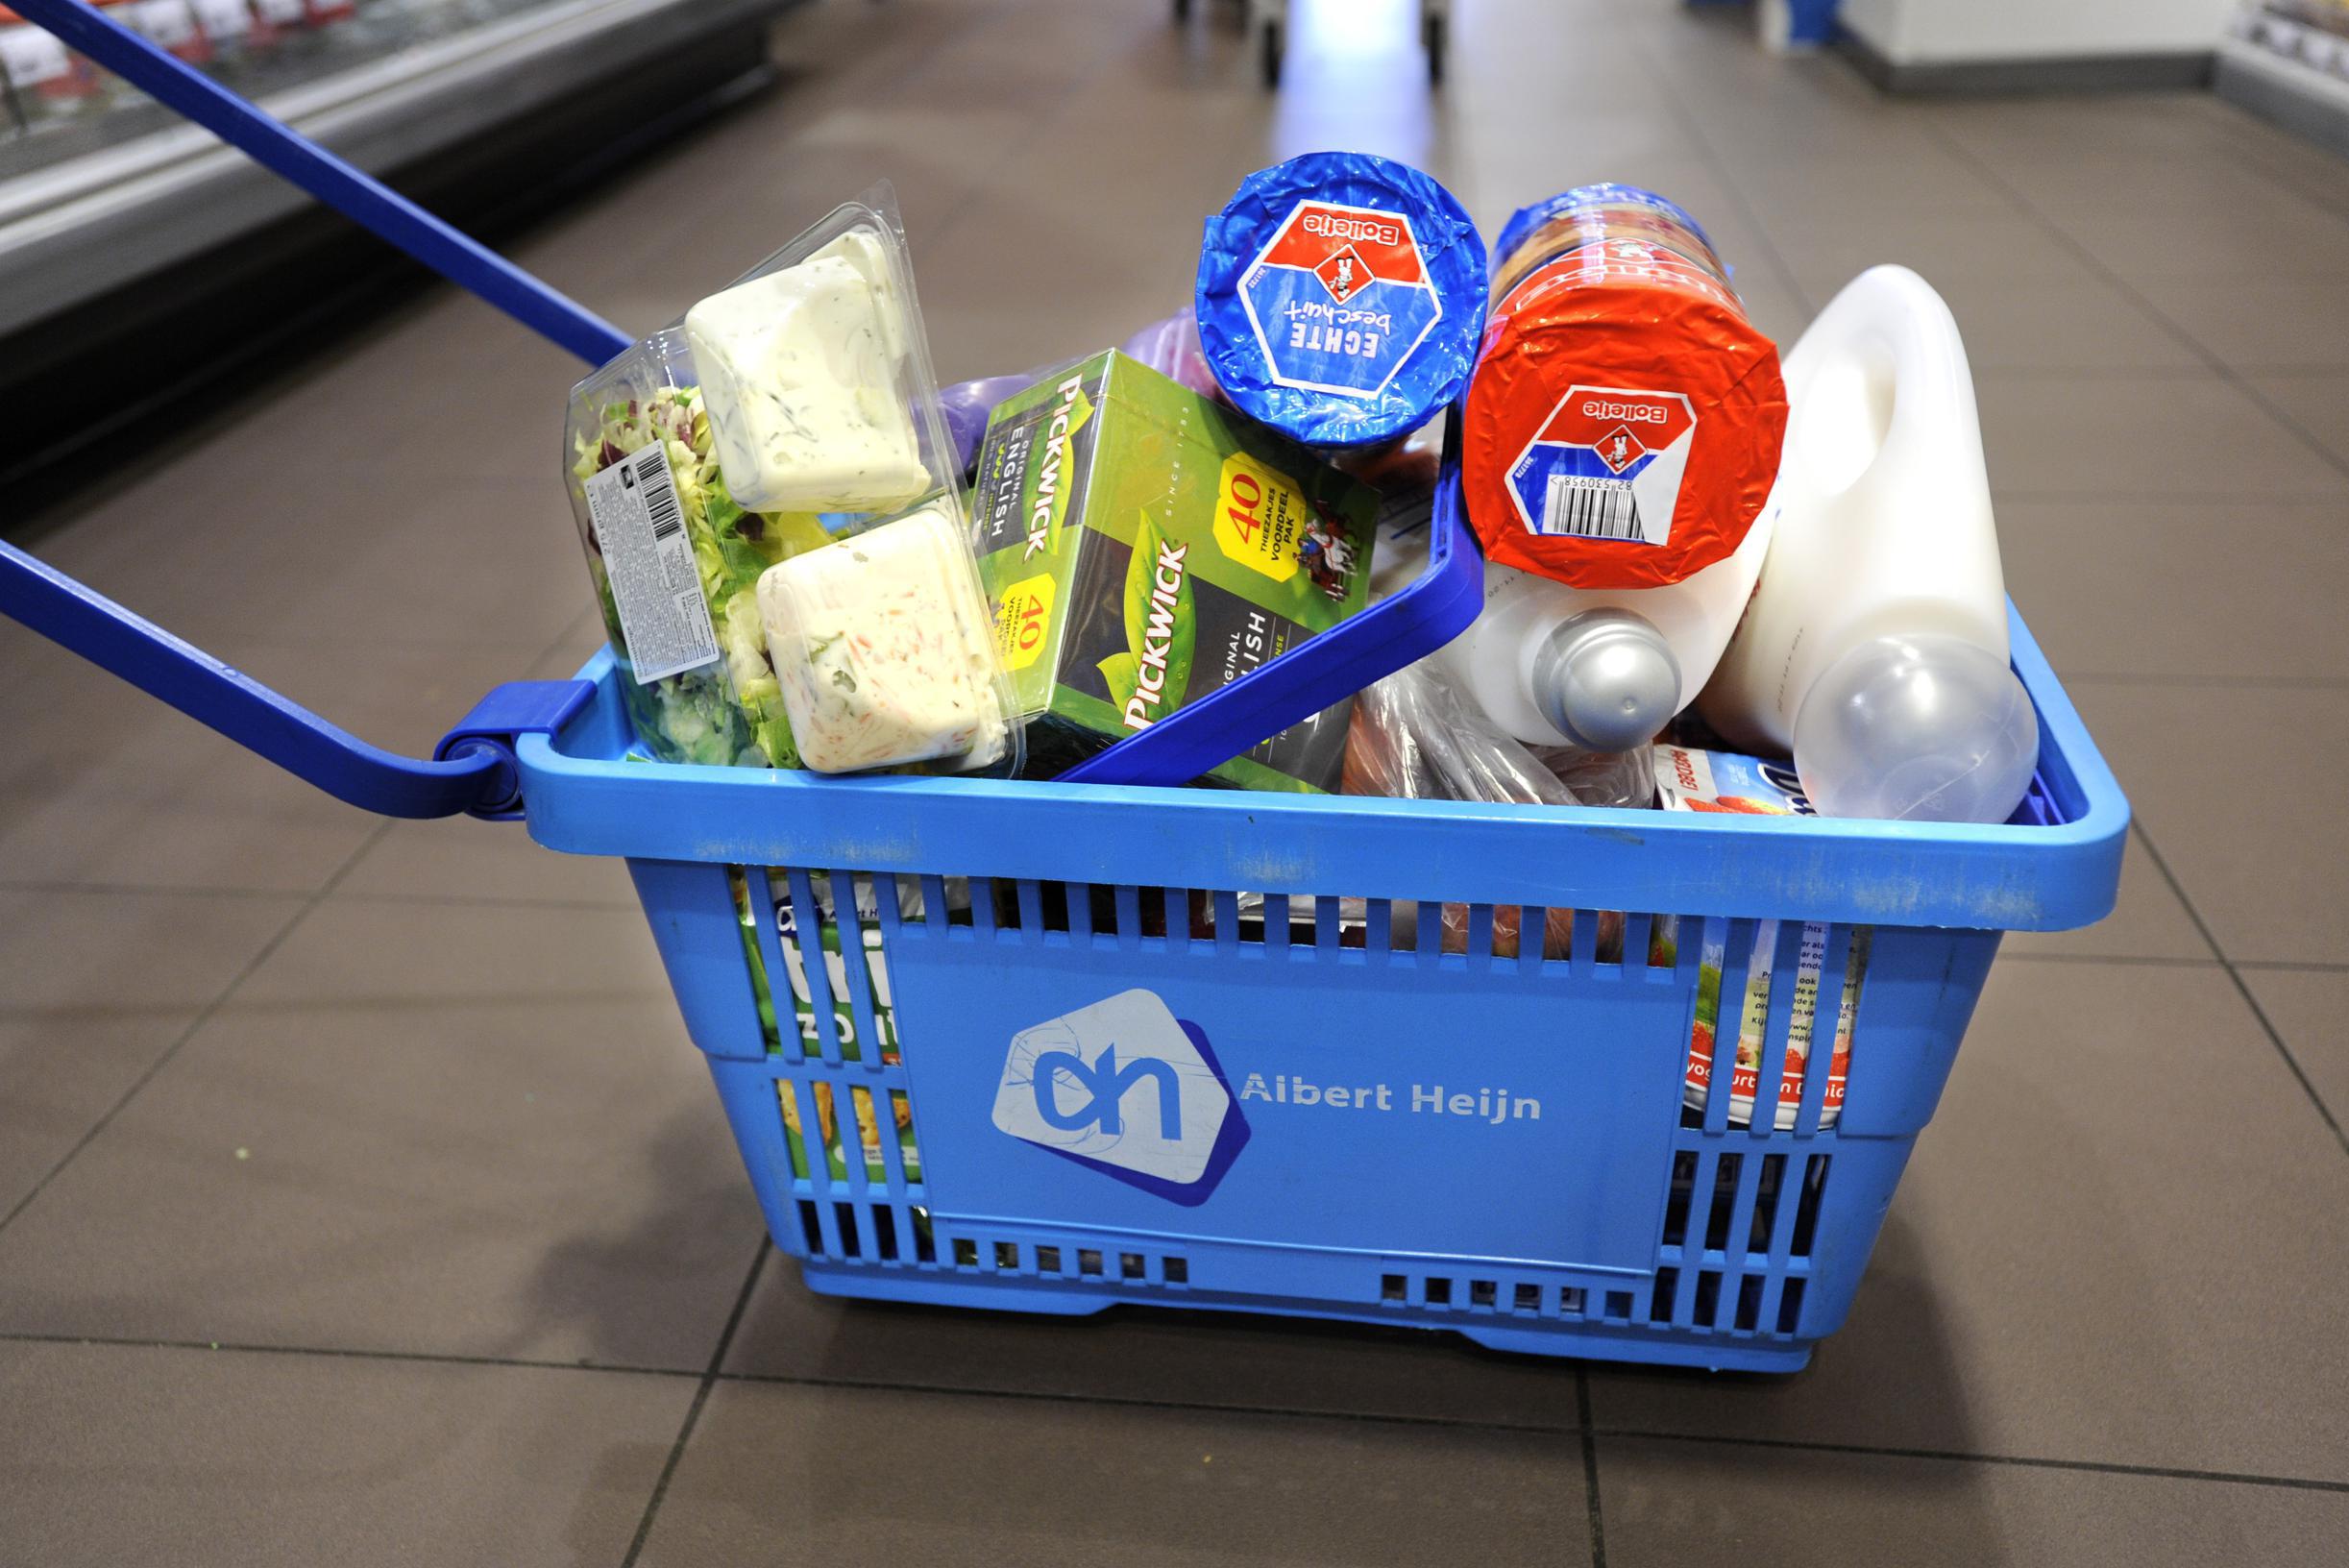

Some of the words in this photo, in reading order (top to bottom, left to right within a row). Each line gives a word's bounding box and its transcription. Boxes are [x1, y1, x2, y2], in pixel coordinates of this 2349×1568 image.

[1301, 212, 1402, 247] Bolletje
[1283, 299, 1392, 337] beschuit
[1288, 322, 1380, 359] ECHTE
[1582, 400, 1668, 425] Bolletje
[991, 426, 1024, 537] ENGLISH
[1009, 440, 1030, 509] ORIGINAL
[1023, 372, 1083, 562] PICKWICK
[1165, 460, 1180, 517] SINCE
[1563, 476, 1611, 489] 530958
[1228, 473, 1261, 544] 40
[1260, 487, 1276, 552] THEEZAKJES
[1270, 491, 1289, 561] VOORDEEL
[1283, 516, 1295, 544] PAK
[1020, 594, 1044, 650] 40
[1123, 538, 1189, 731] PICKWICK
[1240, 1072, 1392, 1112] Albert
[1411, 1084, 1541, 1124] Heijn
